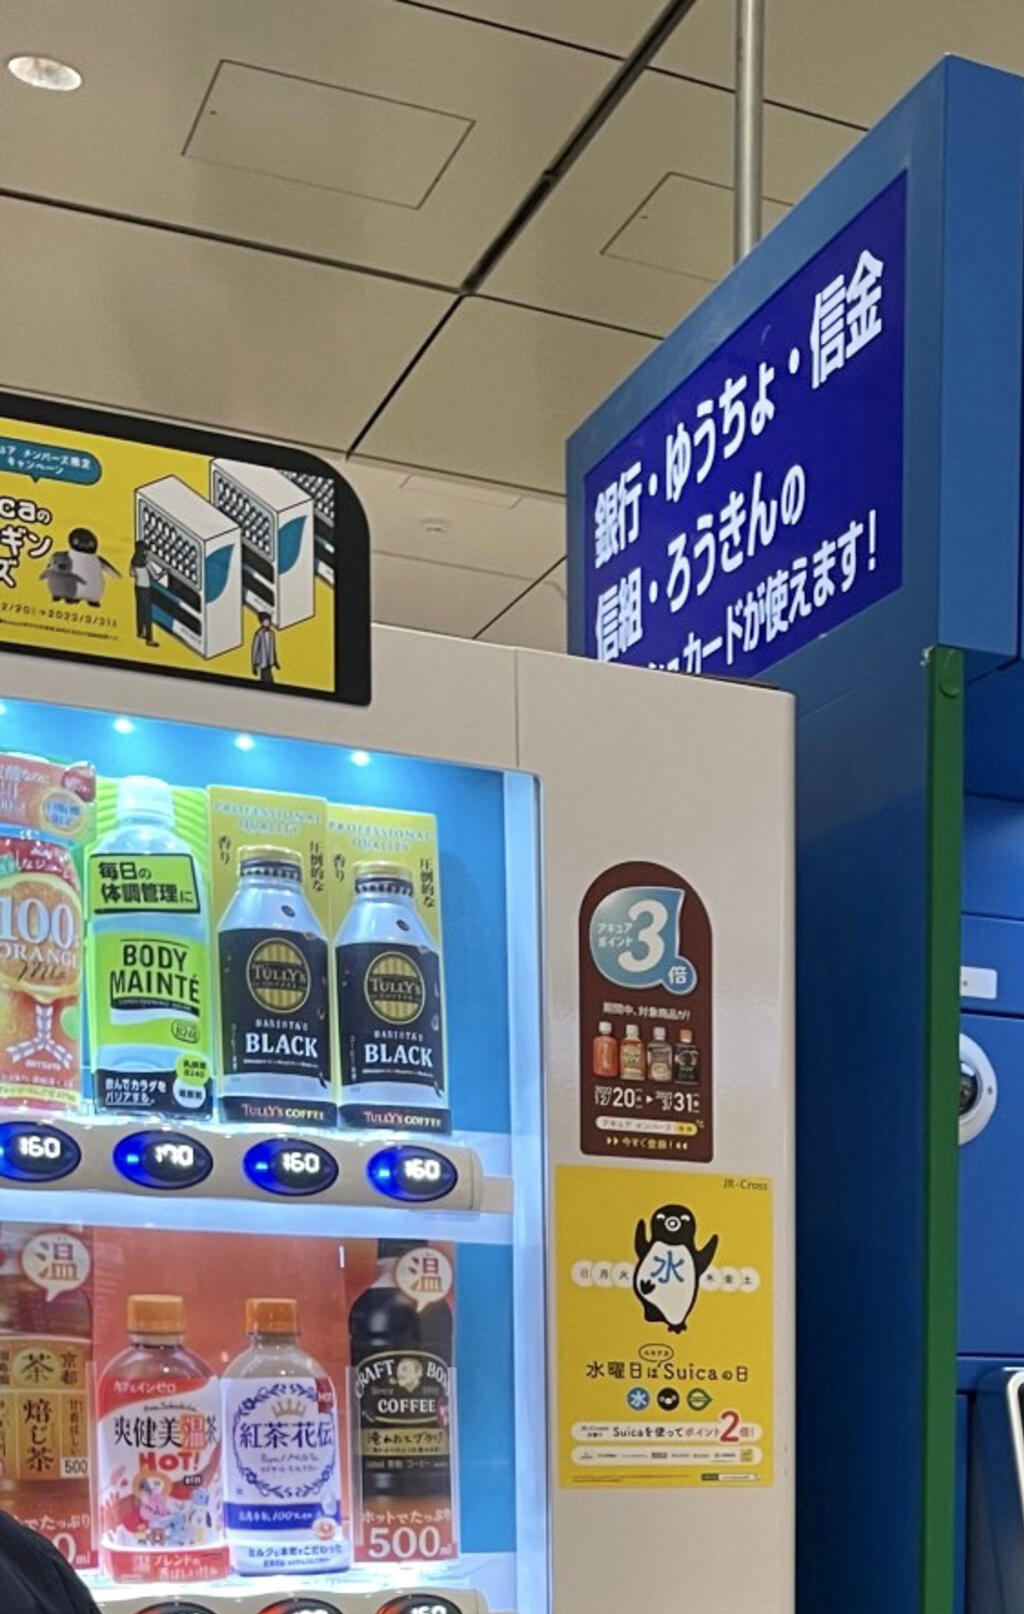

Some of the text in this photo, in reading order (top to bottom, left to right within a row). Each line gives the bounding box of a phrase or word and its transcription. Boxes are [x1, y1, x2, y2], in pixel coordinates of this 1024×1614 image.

[594, 249, 884, 569] 銀行・ゆうちょ・信金
[595, 464, 806, 662] 信組・ろうきんの
[99, 862, 152, 880] 毎日の
[101, 884, 193, 903] 体調管理に
[598, 923, 633, 934] アキュア
[618, 899, 668, 972] 3
[598, 936, 634, 948] ポイント
[123, 944, 187, 972] BODY
[668, 966, 687, 985] 倍
[110, 970, 200, 1004] MAINTÉ
[245, 1033, 318, 1058] BLACK
[365, 1043, 433, 1067] BLACK
[613, 1087, 635, 1108] 20
[674, 1092, 693, 1112] 31
[241, 1103, 325, 1121] TULLY'S COFFEE
[363, 1111, 441, 1128] TULLY'S COFFEE
[20, 1136, 61, 1157] 160
[282, 1153, 320, 1173] 160
[404, 1159, 441, 1180] 160
[723, 1178, 768, 1191] JR-Cross
[35, 1241, 79, 1280] 温
[651, 1250, 685, 1285] 水
[409, 1256, 443, 1292] 温
[580, 1268, 589, 1279] 日
[600, 1269, 609, 1279] 月
[742, 1275, 752, 1285] 土
[21, 1353, 55, 1383] 茶
[586, 1360, 748, 1383] 水曜日はSuicaの日
[114, 1381, 176, 1393] カフェインゼロ
[377, 1399, 436, 1413] COFFEE
[23, 1398, 54, 1472] 焙じ茶
[239, 1421, 333, 1449] 紅茶花伝
[64, 1460, 88, 1473] 500
[139, 1452, 200, 1472] HOT!
